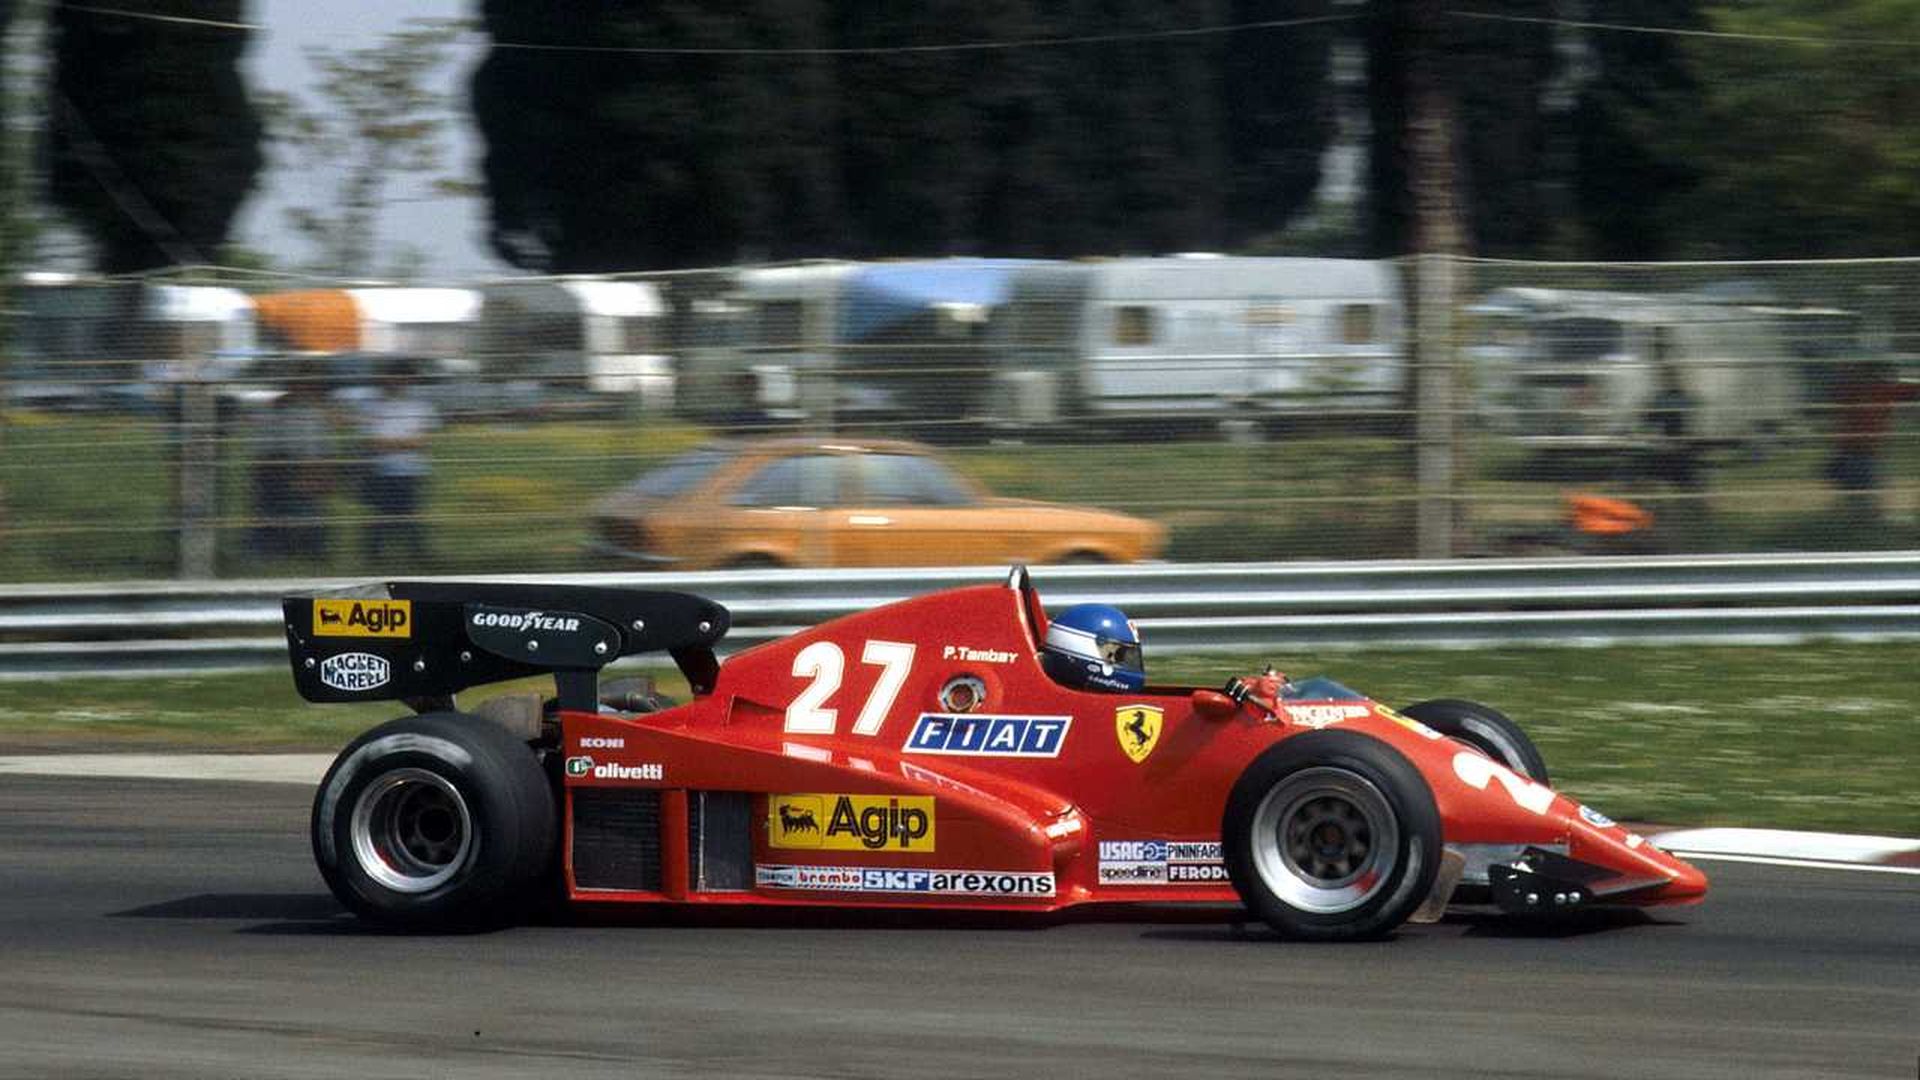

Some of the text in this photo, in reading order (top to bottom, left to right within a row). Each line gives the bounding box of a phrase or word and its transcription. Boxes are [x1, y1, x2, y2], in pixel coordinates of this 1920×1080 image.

[348, 602, 406, 632] Agip
[473, 612, 579, 631] GOODYEAR
[784, 640, 917, 736] 27
[919, 720, 1059, 750] FIAT
[594, 763, 663, 779] olivetti
[826, 796, 928, 848] Agip
[1100, 842, 1144, 860] USAG
[799, 872, 861, 883] brembo
[864, 871, 927, 889] SKF
[933, 874, 1052, 892] arexons
